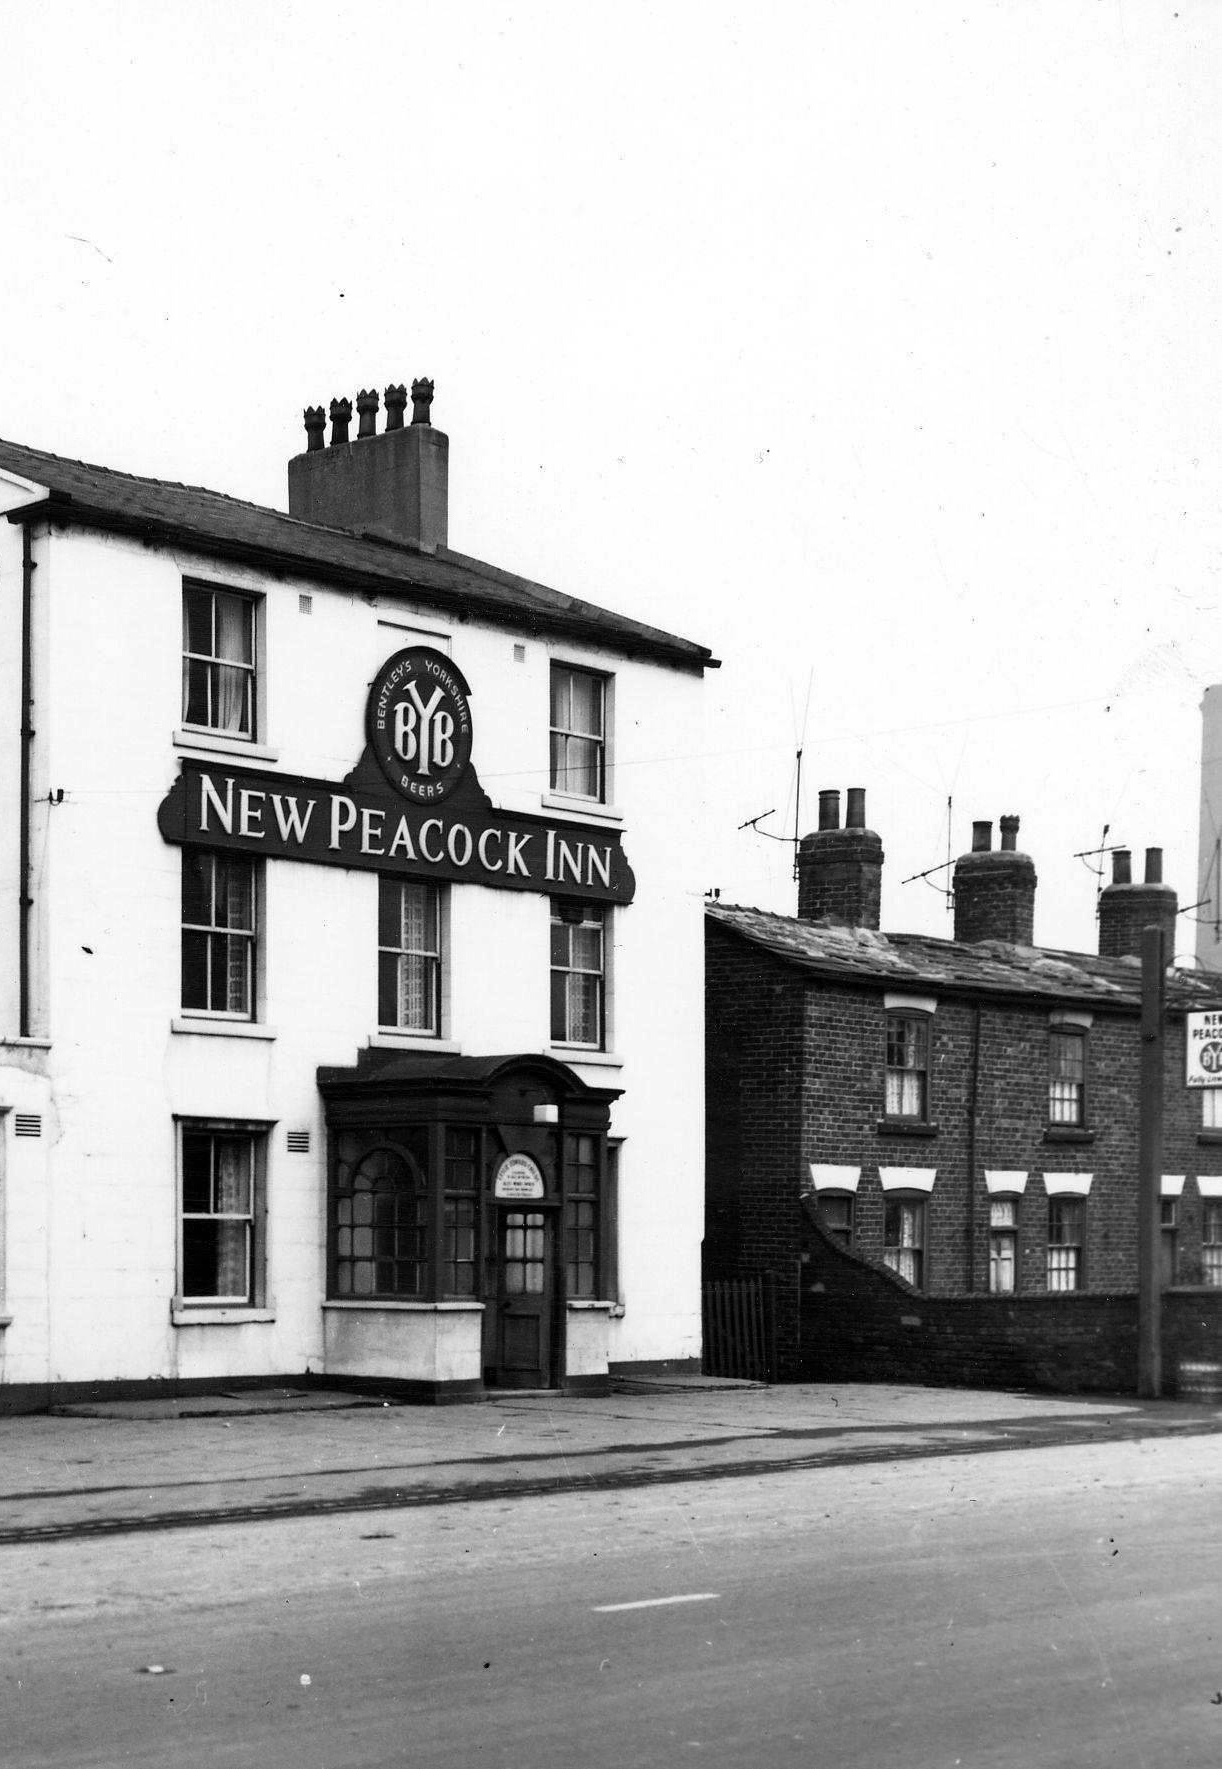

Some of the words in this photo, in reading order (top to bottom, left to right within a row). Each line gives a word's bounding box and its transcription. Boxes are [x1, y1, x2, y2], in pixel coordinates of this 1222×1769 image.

[377, 659, 413, 730] BENTLEY'S
[425, 659, 469, 735] YORKSHIRE
[393, 679, 455, 777] BYB
[400, 774, 445, 798] BEERS
[198, 773, 317, 845] NEW
[328, 794, 533, 877] PEACOCK
[544, 829, 612, 888] INN
